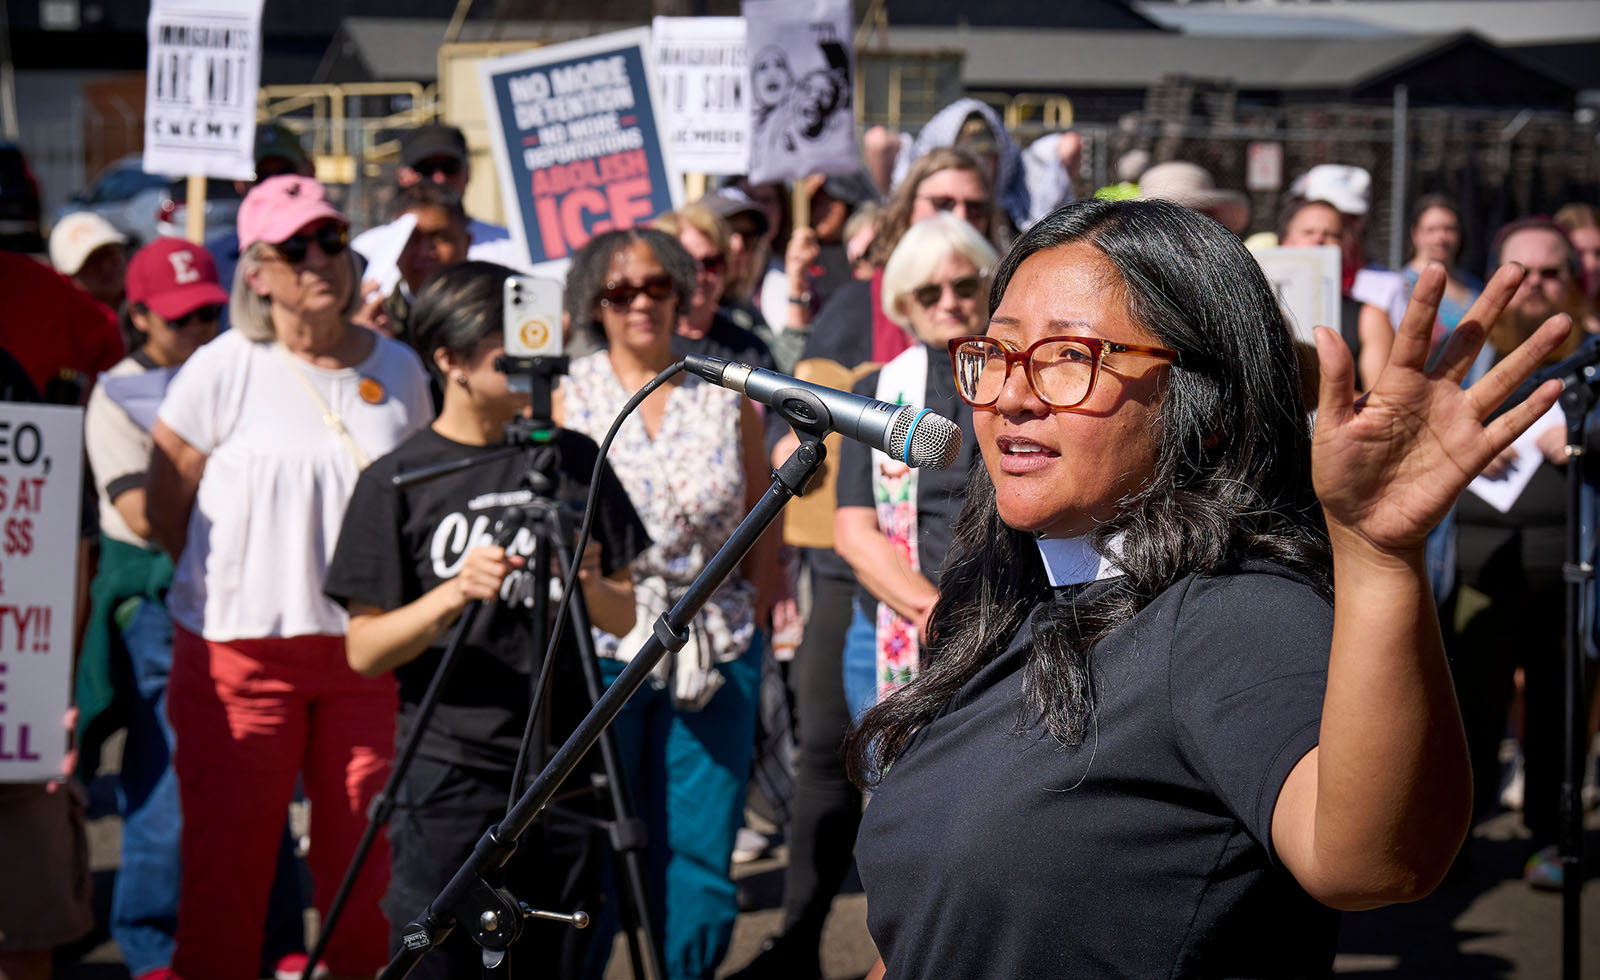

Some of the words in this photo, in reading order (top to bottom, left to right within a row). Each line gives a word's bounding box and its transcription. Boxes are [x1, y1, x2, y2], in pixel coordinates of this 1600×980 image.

[156, 53, 194, 105] ARE
[206, 56, 248, 107] NOT
[508, 71, 550, 106] NO
[550, 55, 627, 98] MORE
[513, 80, 635, 131] DETENTION
[537, 123, 568, 146] NO
[566, 112, 620, 138] MORE
[523, 127, 644, 171] DEPORTATIONS
[531, 148, 649, 197] ABOLISH
[534, 175, 654, 260] ICE
[168, 251, 199, 285] E
[14, 477, 46, 513] AT
